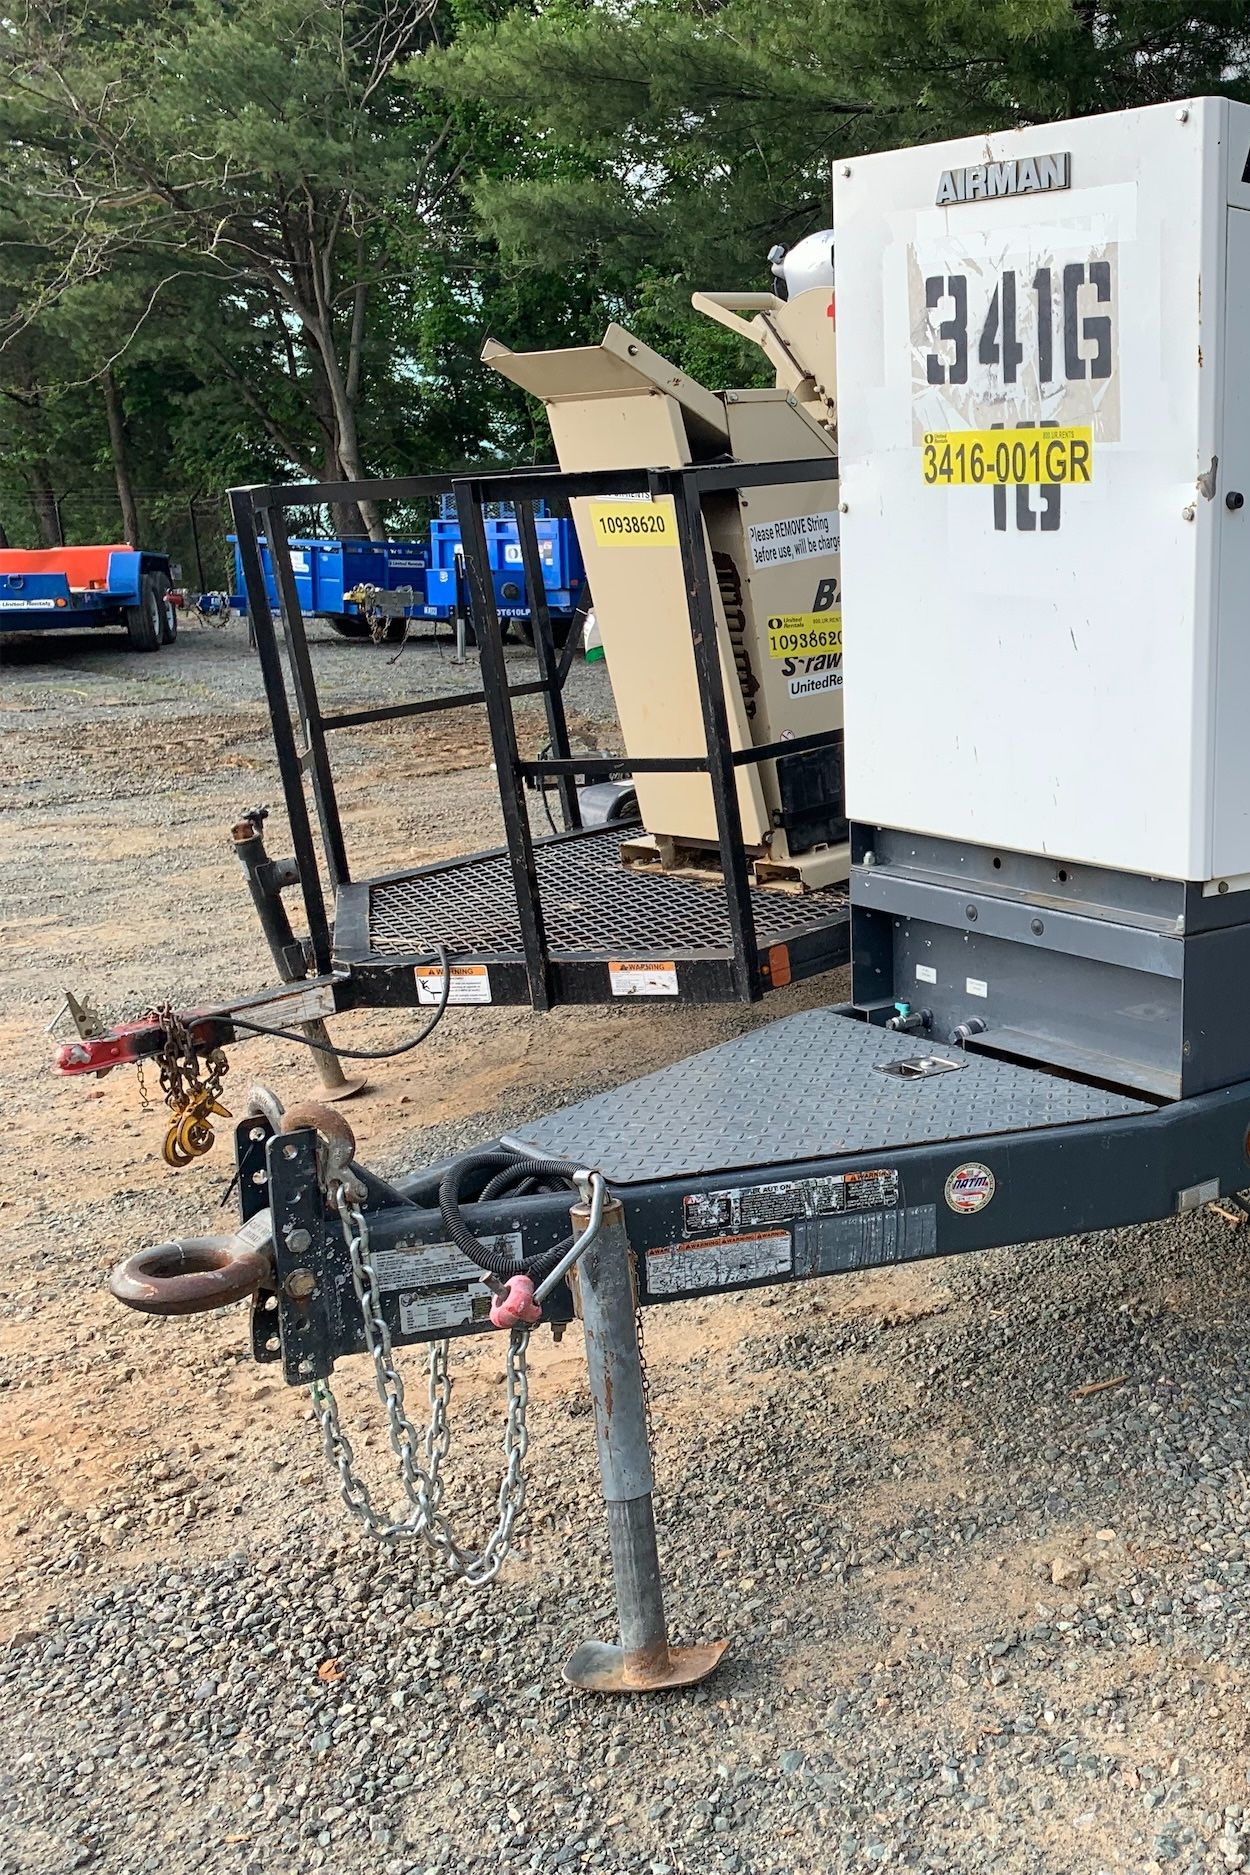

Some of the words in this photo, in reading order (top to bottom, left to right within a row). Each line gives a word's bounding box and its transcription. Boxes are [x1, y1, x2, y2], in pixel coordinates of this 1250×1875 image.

[937, 153, 1068, 205] AIRMAN
[923, 439, 1091, 484] 3416-001GR
[599, 515, 666, 534] 10938620
[750, 526, 774, 543] Please
[774, 518, 808, 539] REMOVE
[807, 515, 829, 533] String
[794, 536, 808, 555] will
[808, 537, 817, 552] be
[784, 616, 803, 624] United
[436, 967, 475, 976] WRNING
